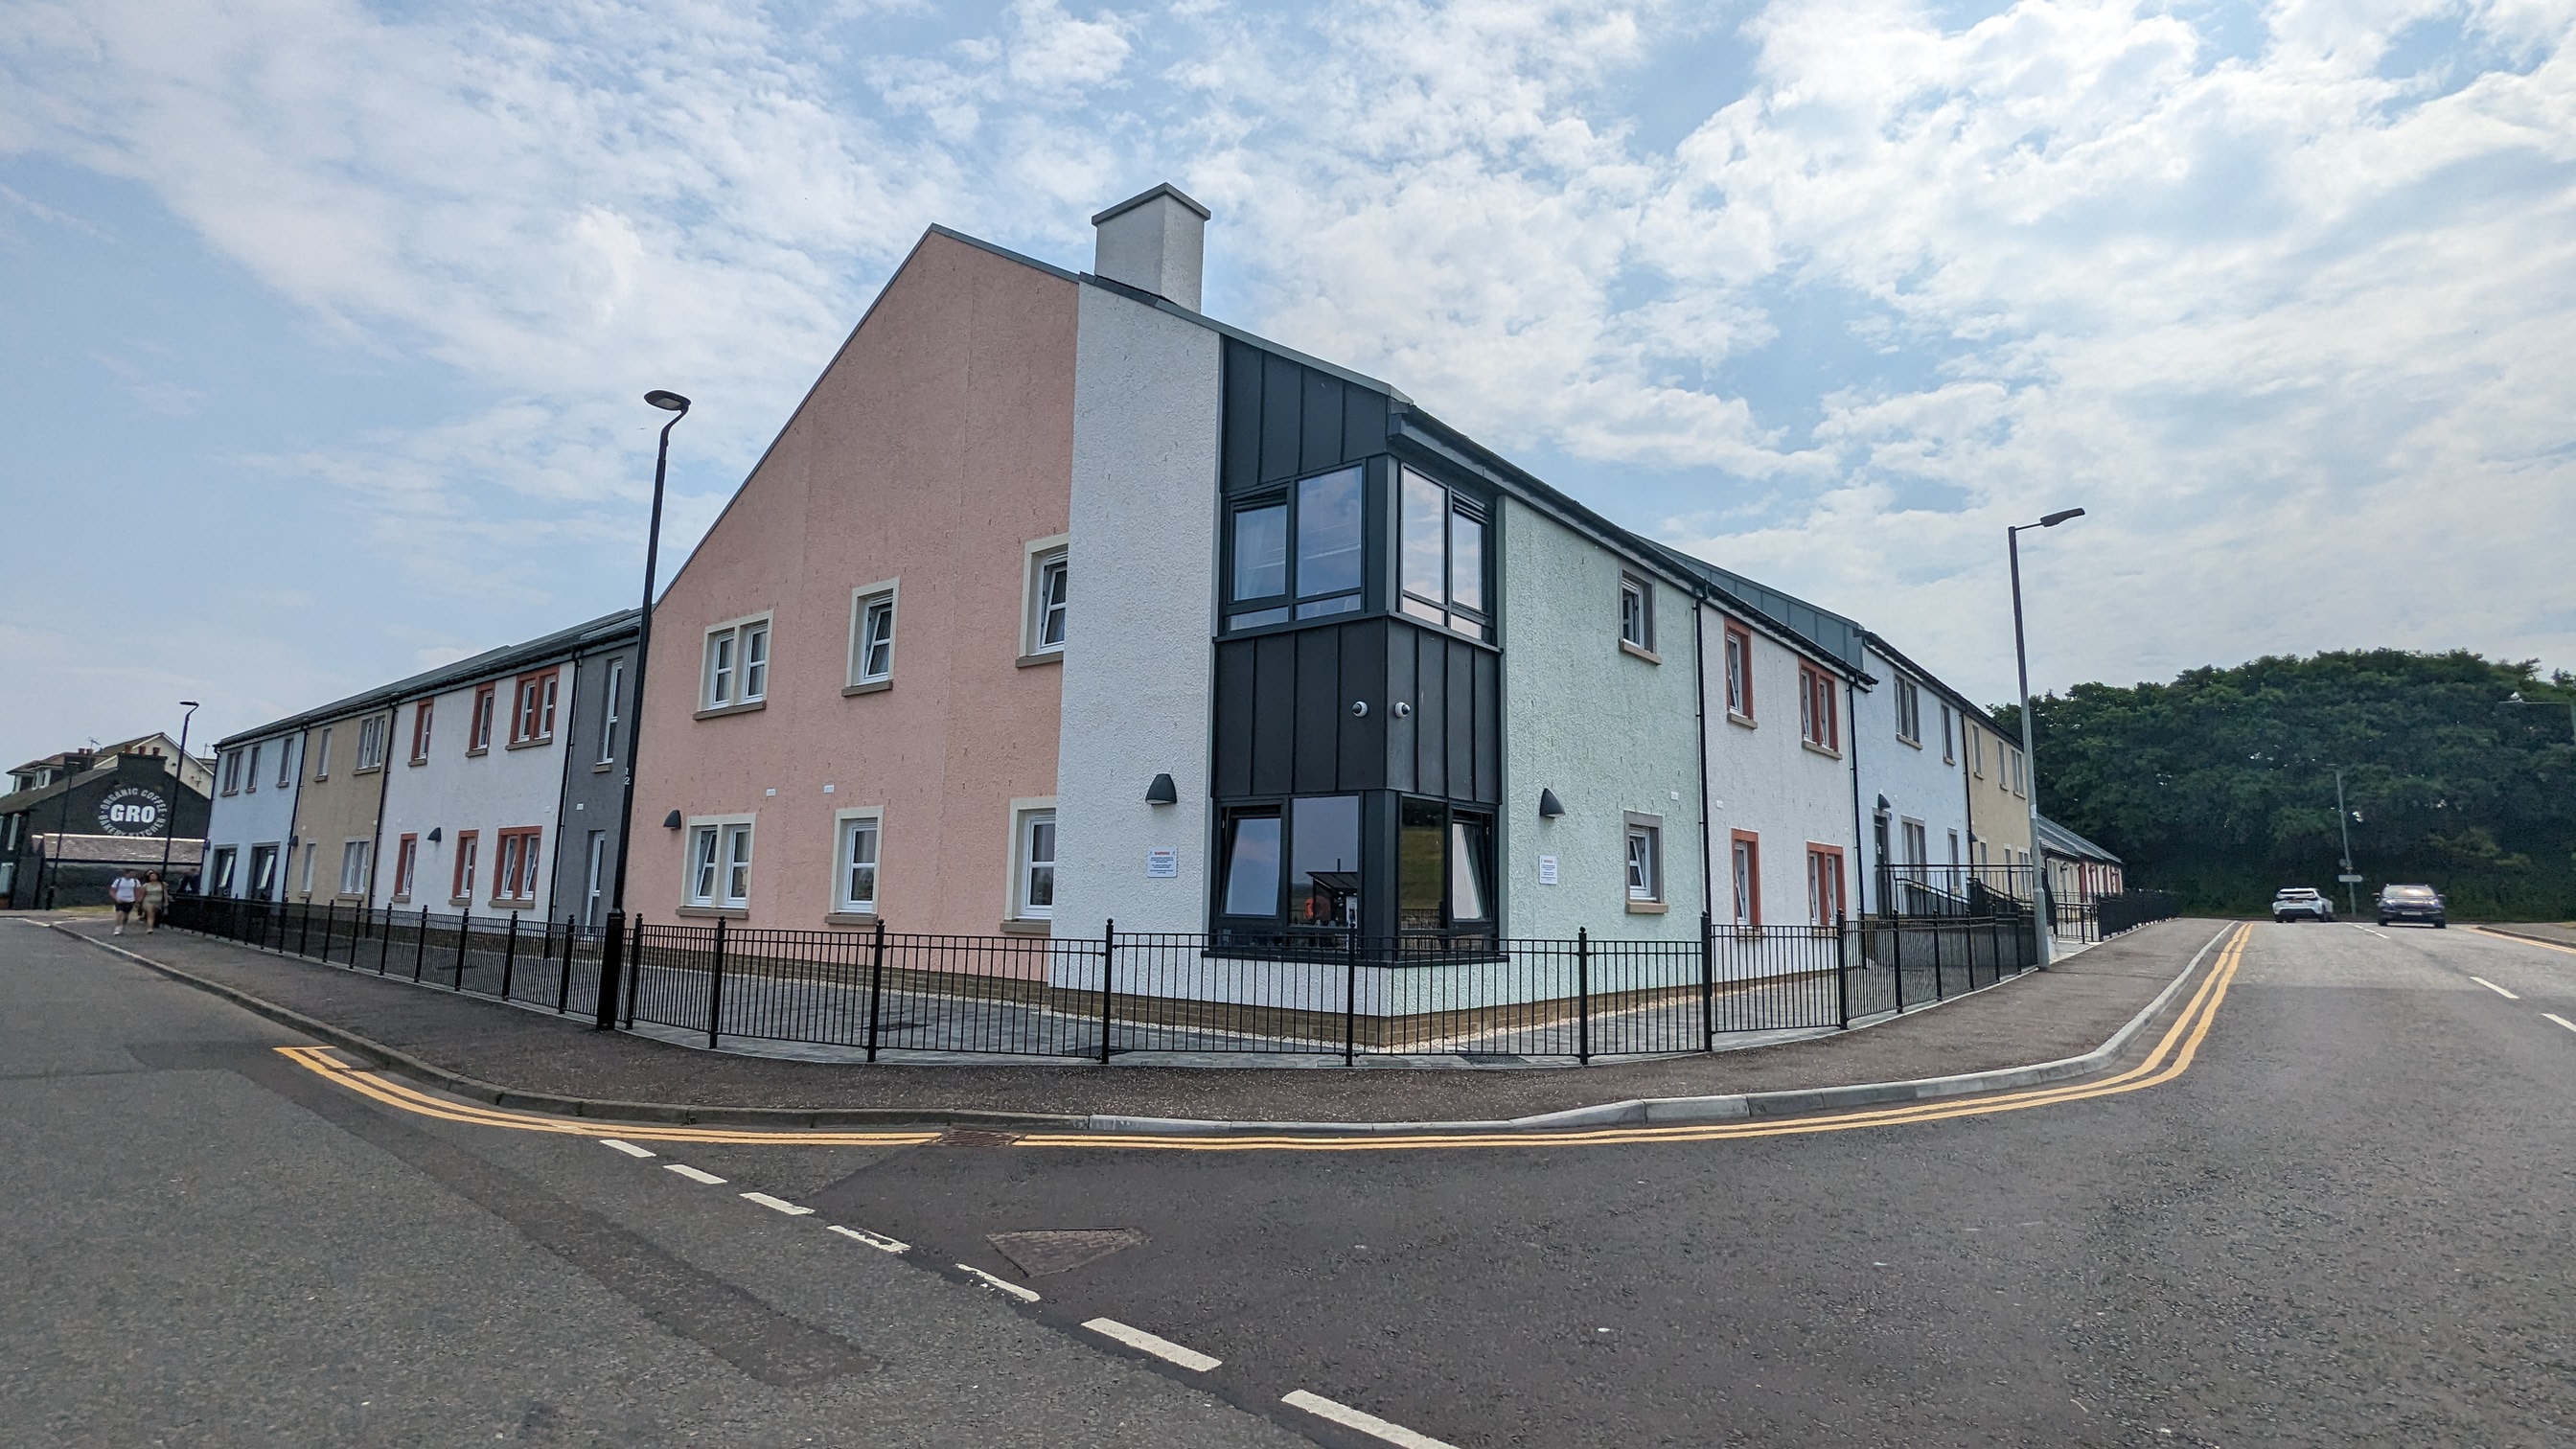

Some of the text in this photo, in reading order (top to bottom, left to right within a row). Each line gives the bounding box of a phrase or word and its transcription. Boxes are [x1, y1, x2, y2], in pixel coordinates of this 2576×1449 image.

[100, 788, 167, 813] ORGANIC COFFEE
[110, 804, 155, 823] GRO
